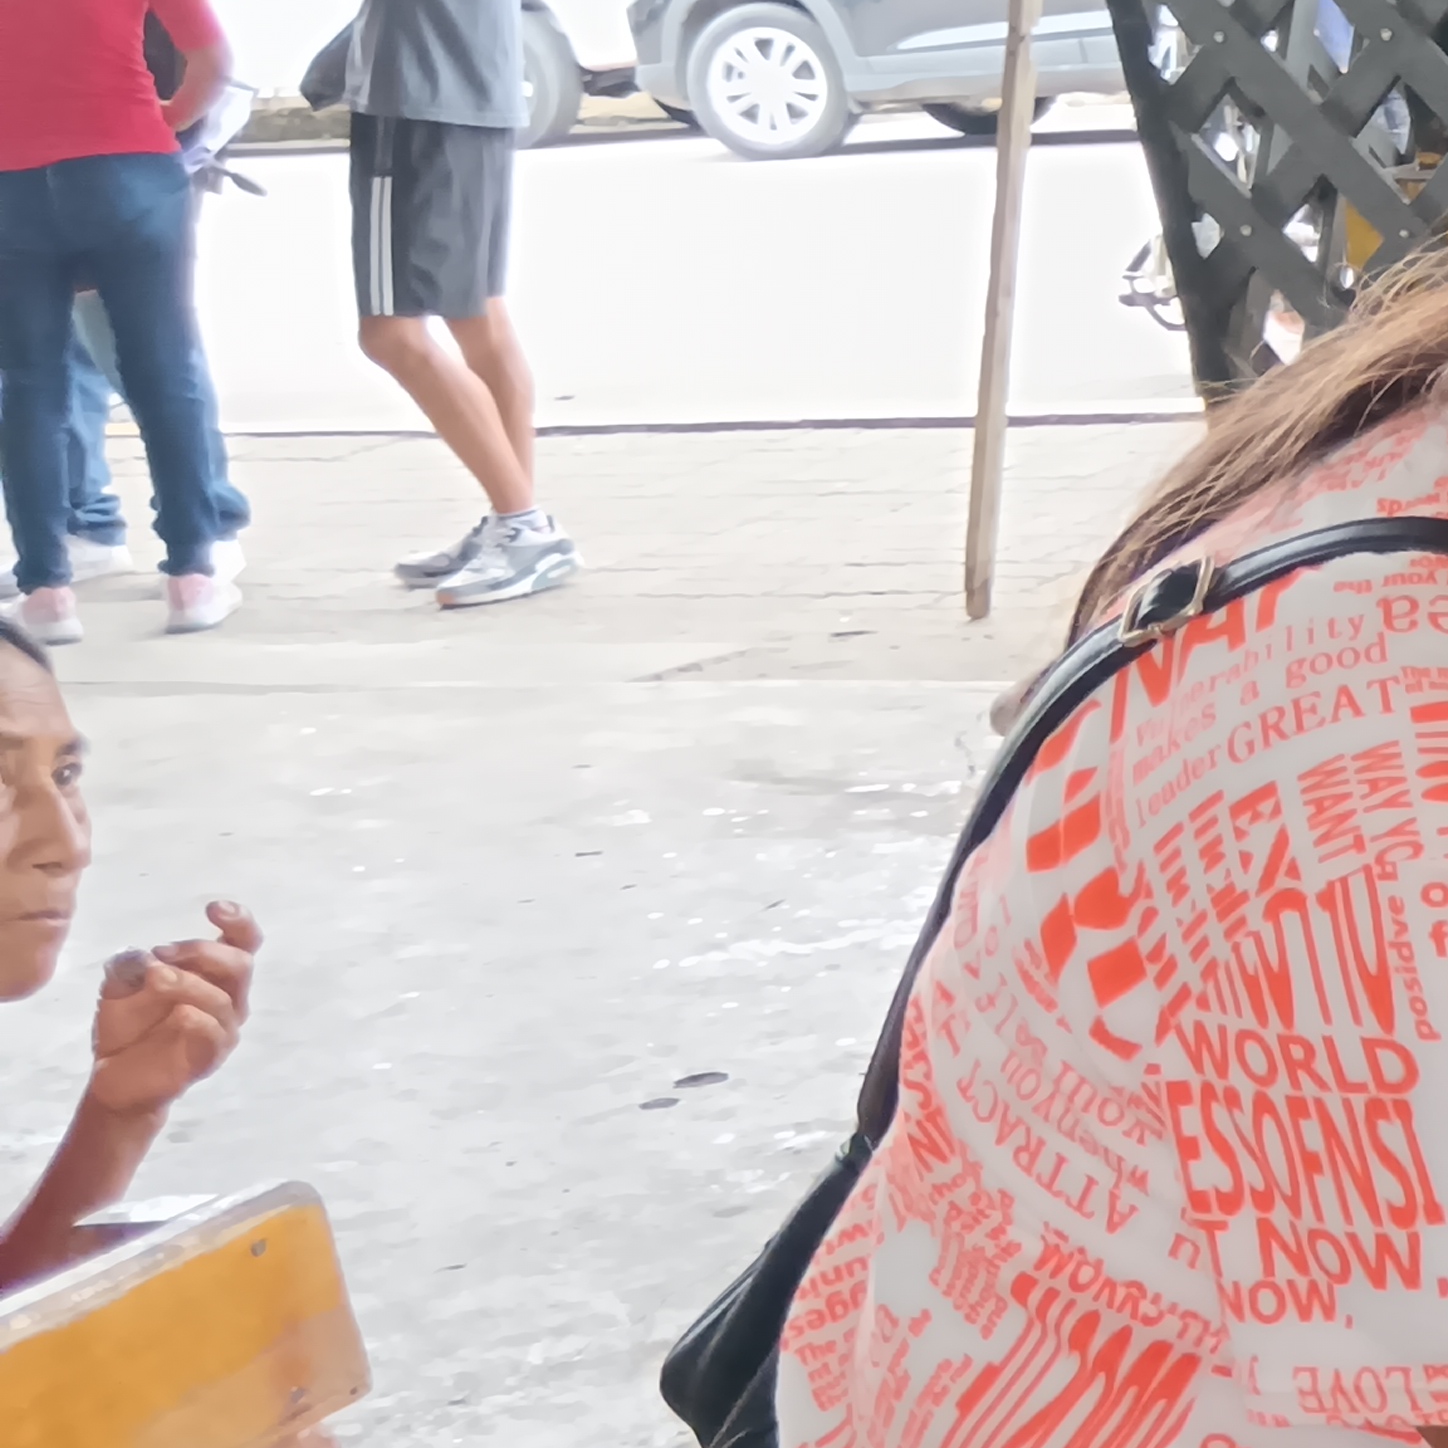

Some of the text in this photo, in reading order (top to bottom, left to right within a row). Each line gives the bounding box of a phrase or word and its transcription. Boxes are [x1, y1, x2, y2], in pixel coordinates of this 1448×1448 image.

[1284, 631, 1390, 691] good
[1224, 670, 1403, 765] GREAT
[1298, 752, 1368, 865] WANT
[1351, 738, 1414, 815] WAY
[1172, 1018, 1421, 1096] WORLD
